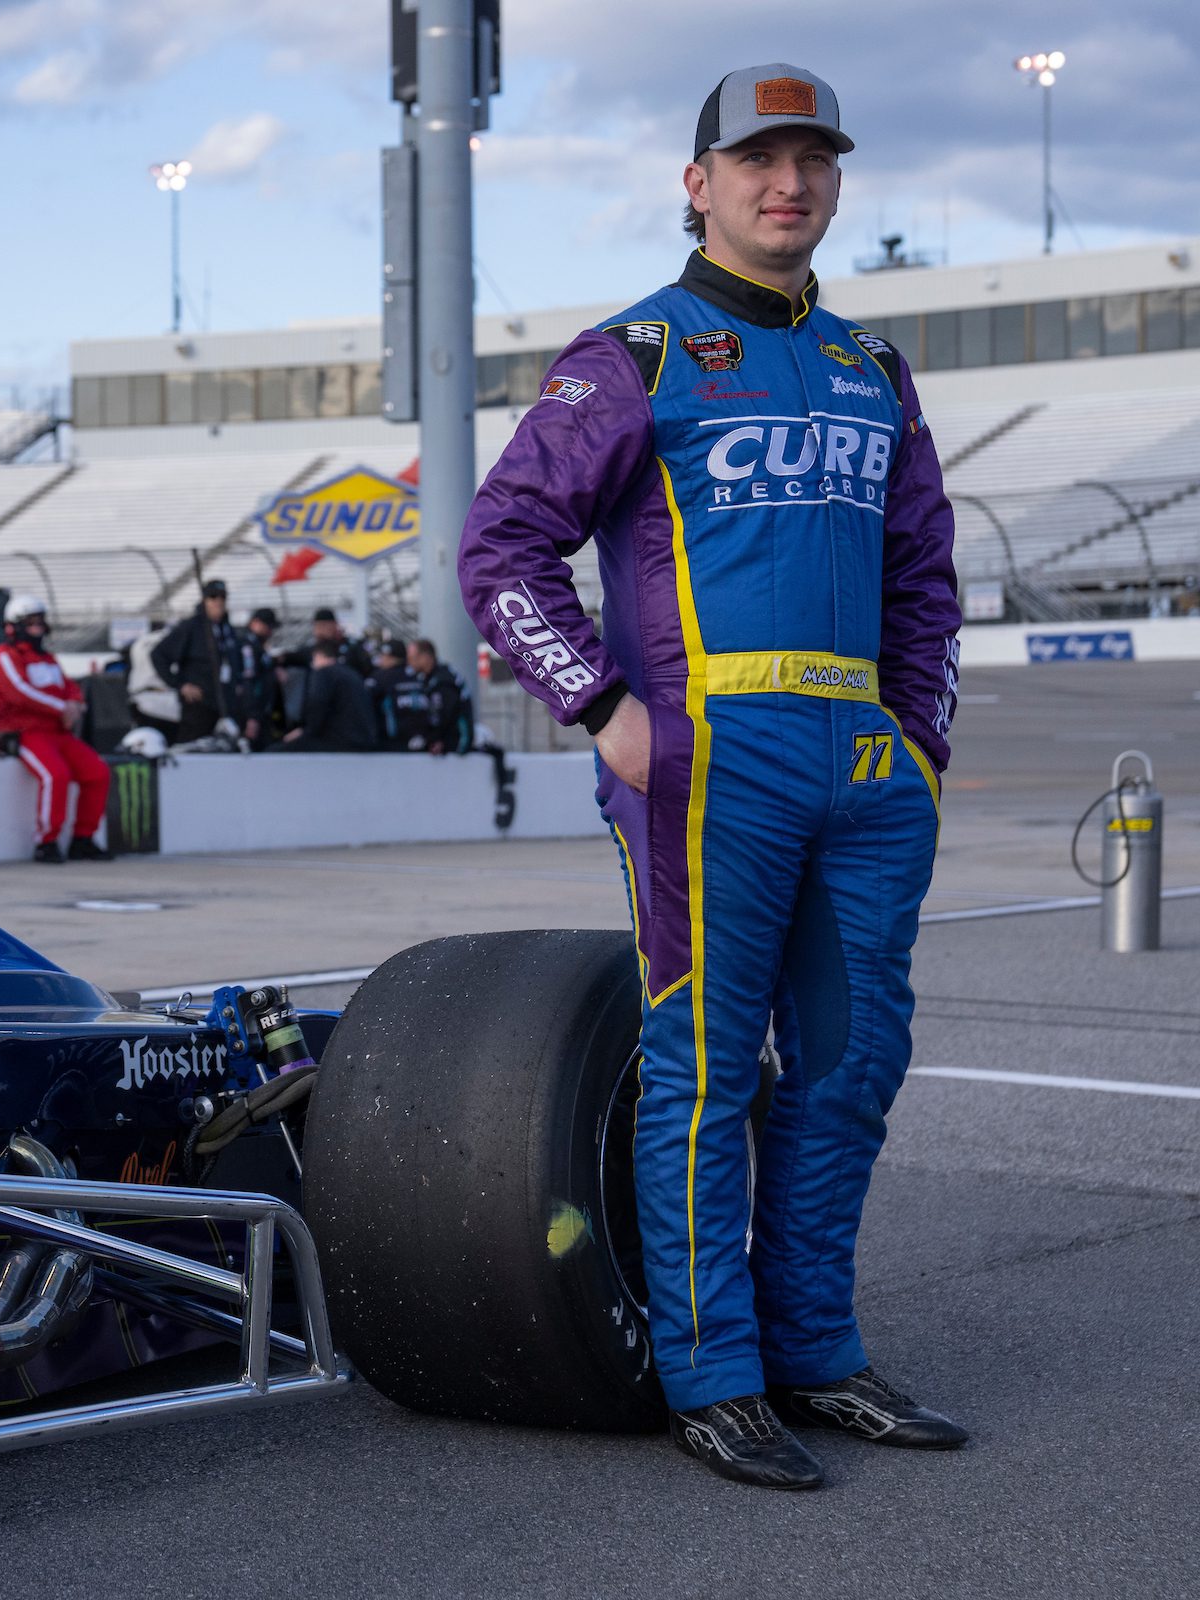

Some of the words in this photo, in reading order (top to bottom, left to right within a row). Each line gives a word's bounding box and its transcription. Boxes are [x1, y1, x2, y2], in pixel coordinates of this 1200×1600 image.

[627, 336, 661, 346] SIMPSON
[696, 333, 727, 345] NASCAR
[820, 345, 862, 363] SUNOCO
[829, 375, 880, 400] Hoosier
[706, 423, 891, 481] CURB
[714, 476, 886, 507] RECORDS
[272, 501, 419, 533] SUNOC
[491, 601, 575, 704] RECORDS
[498, 590, 595, 692] CURB
[800, 665, 843, 686] MAD
[842, 669, 869, 689] MAX
[848, 731, 894, 785] 77
[260, 1012, 280, 1030] RF
[115, 1032, 228, 1091] Hoosier
